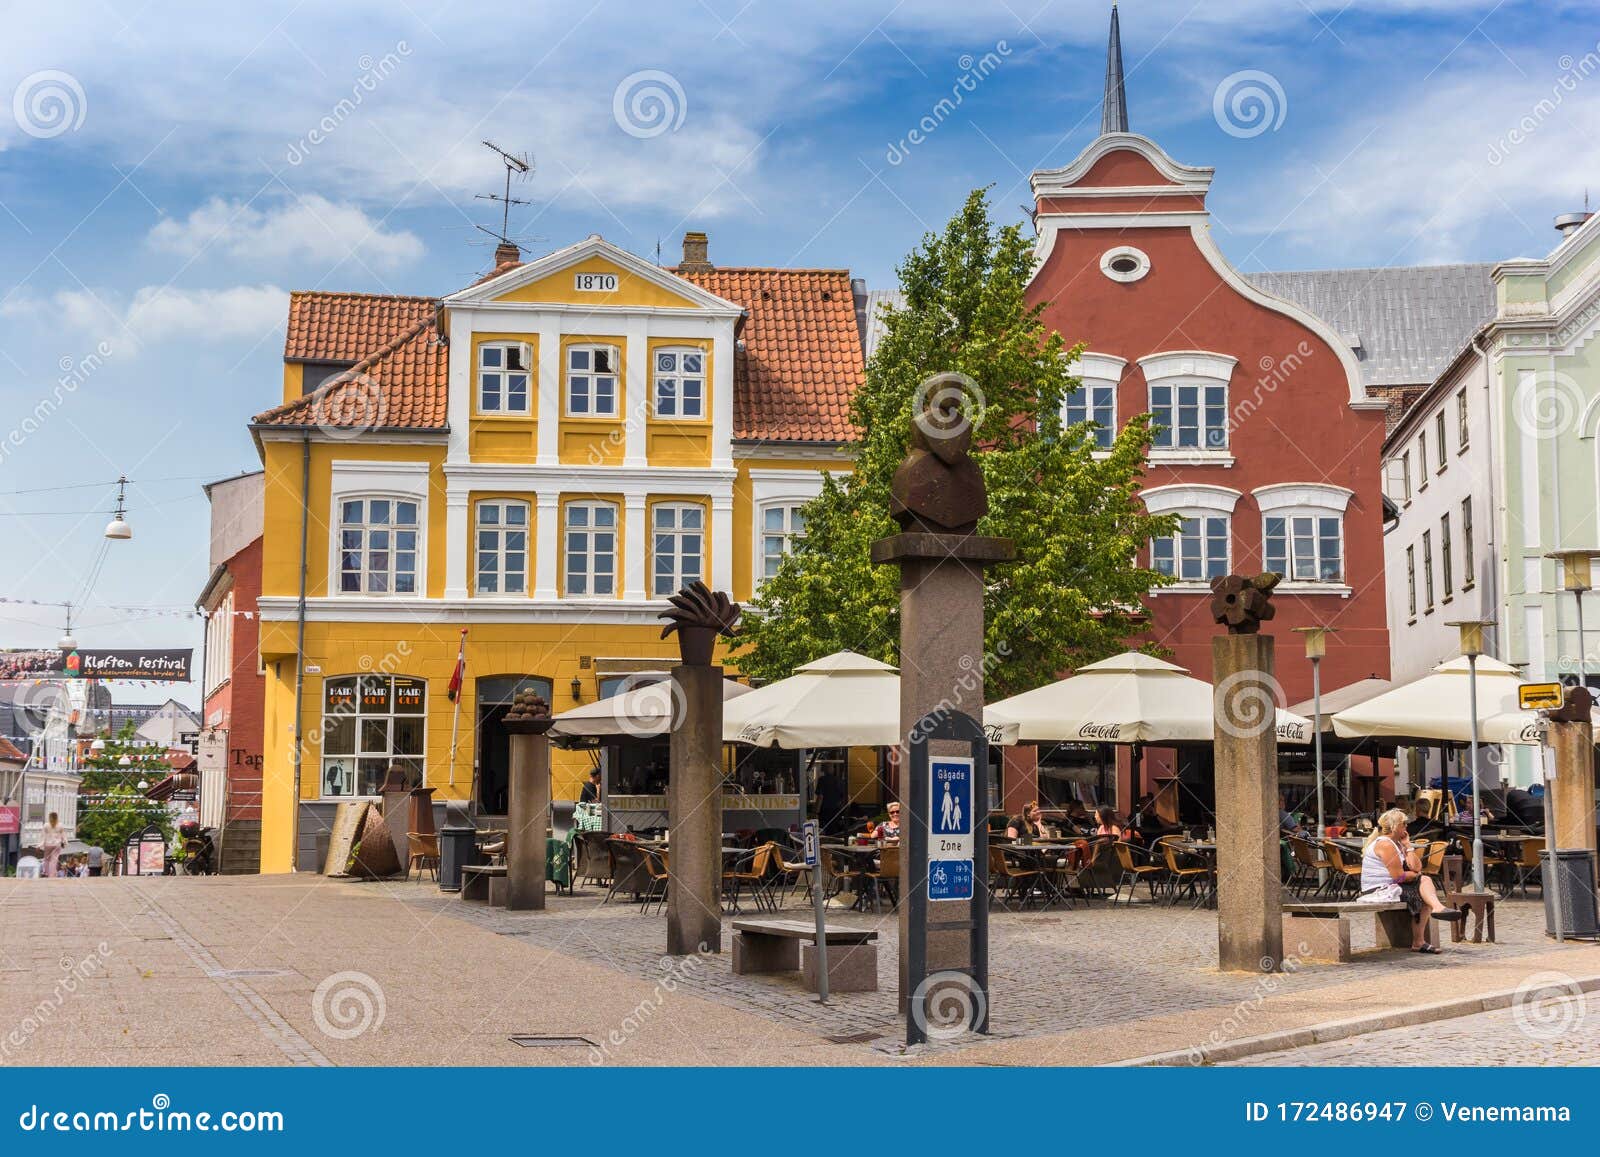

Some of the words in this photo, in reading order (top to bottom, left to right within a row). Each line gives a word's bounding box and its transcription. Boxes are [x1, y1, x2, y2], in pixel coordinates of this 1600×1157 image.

[576, 275, 615, 290] 1870
[84, 655, 133, 669] Kløften
[330, 688, 353, 696] HAIR
[364, 688, 387, 696] HAIR
[398, 688, 421, 696] HAIR
[364, 696, 385, 704] CUT
[398, 696, 419, 704] CUT
[938, 768, 965, 781] Gågade
[941, 840, 962, 851] Zone
